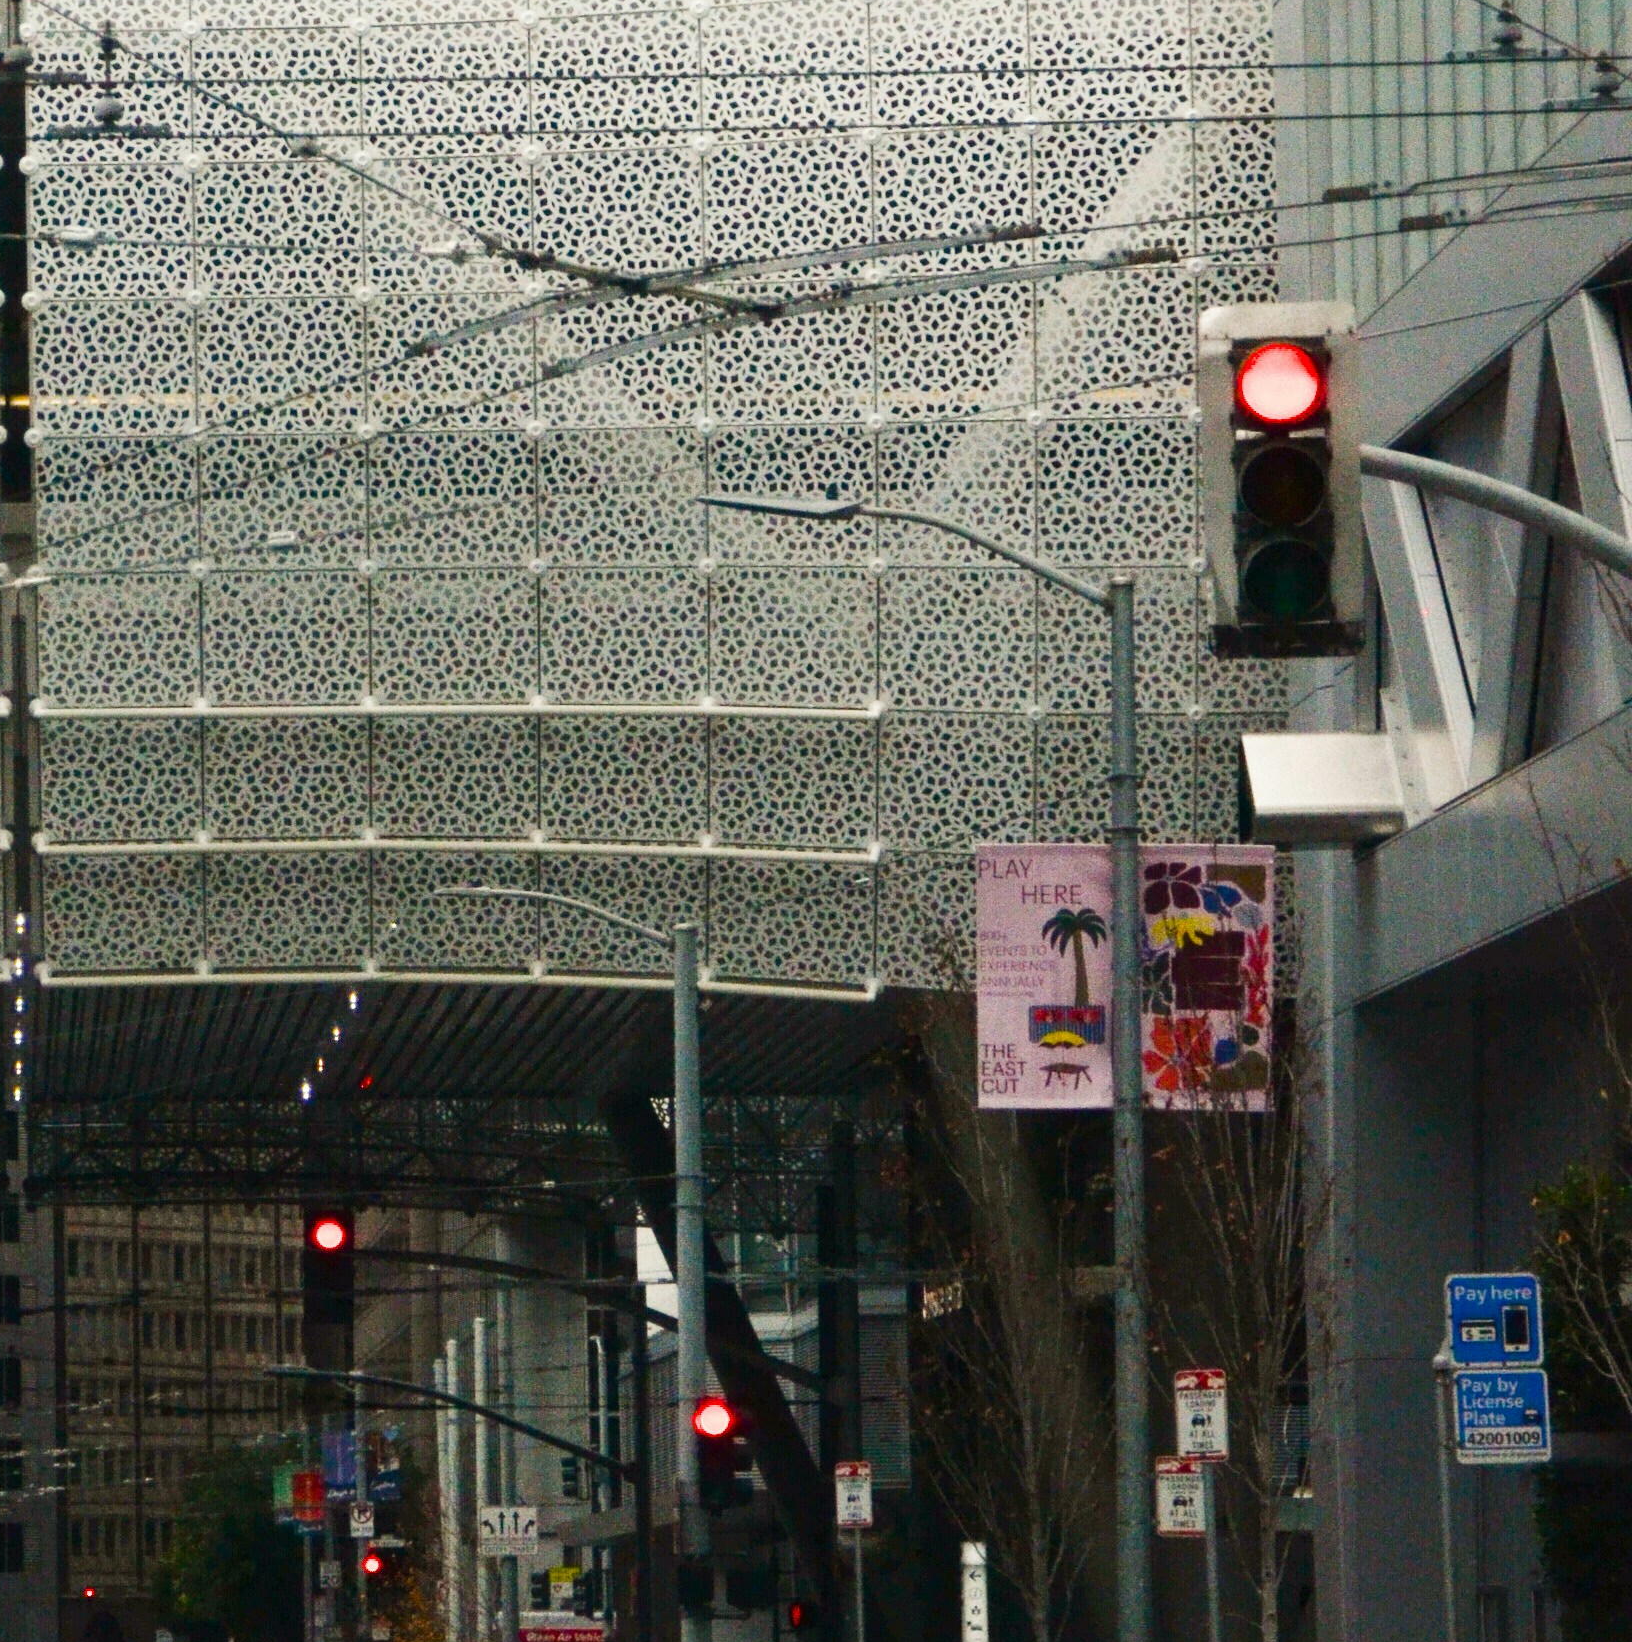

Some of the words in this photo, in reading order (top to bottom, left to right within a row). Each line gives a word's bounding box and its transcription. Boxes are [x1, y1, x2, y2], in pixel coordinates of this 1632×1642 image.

[977, 859, 1033, 879] PLAY
[1021, 884, 1082, 905] HERE
[980, 945, 1027, 956] EVENTS
[1031, 945, 1047, 956] TO
[980, 960, 1060, 971] EXPERIENCE
[980, 975, 1045, 987] ANNUALLY
[981, 1043, 1017, 1059] THE
[981, 1061, 1027, 1076] EAST
[981, 1078, 1020, 1094] CUT
[1454, 1285, 1487, 1305] Pay
[1491, 1284, 1533, 1301] here
[1461, 1378, 1492, 1396] Pay
[1497, 1377, 1518, 1395] by
[1462, 1394, 1525, 1409] License
[1463, 1411, 1506, 1426] Plate
[1467, 1431, 1541, 1445] 42001009
